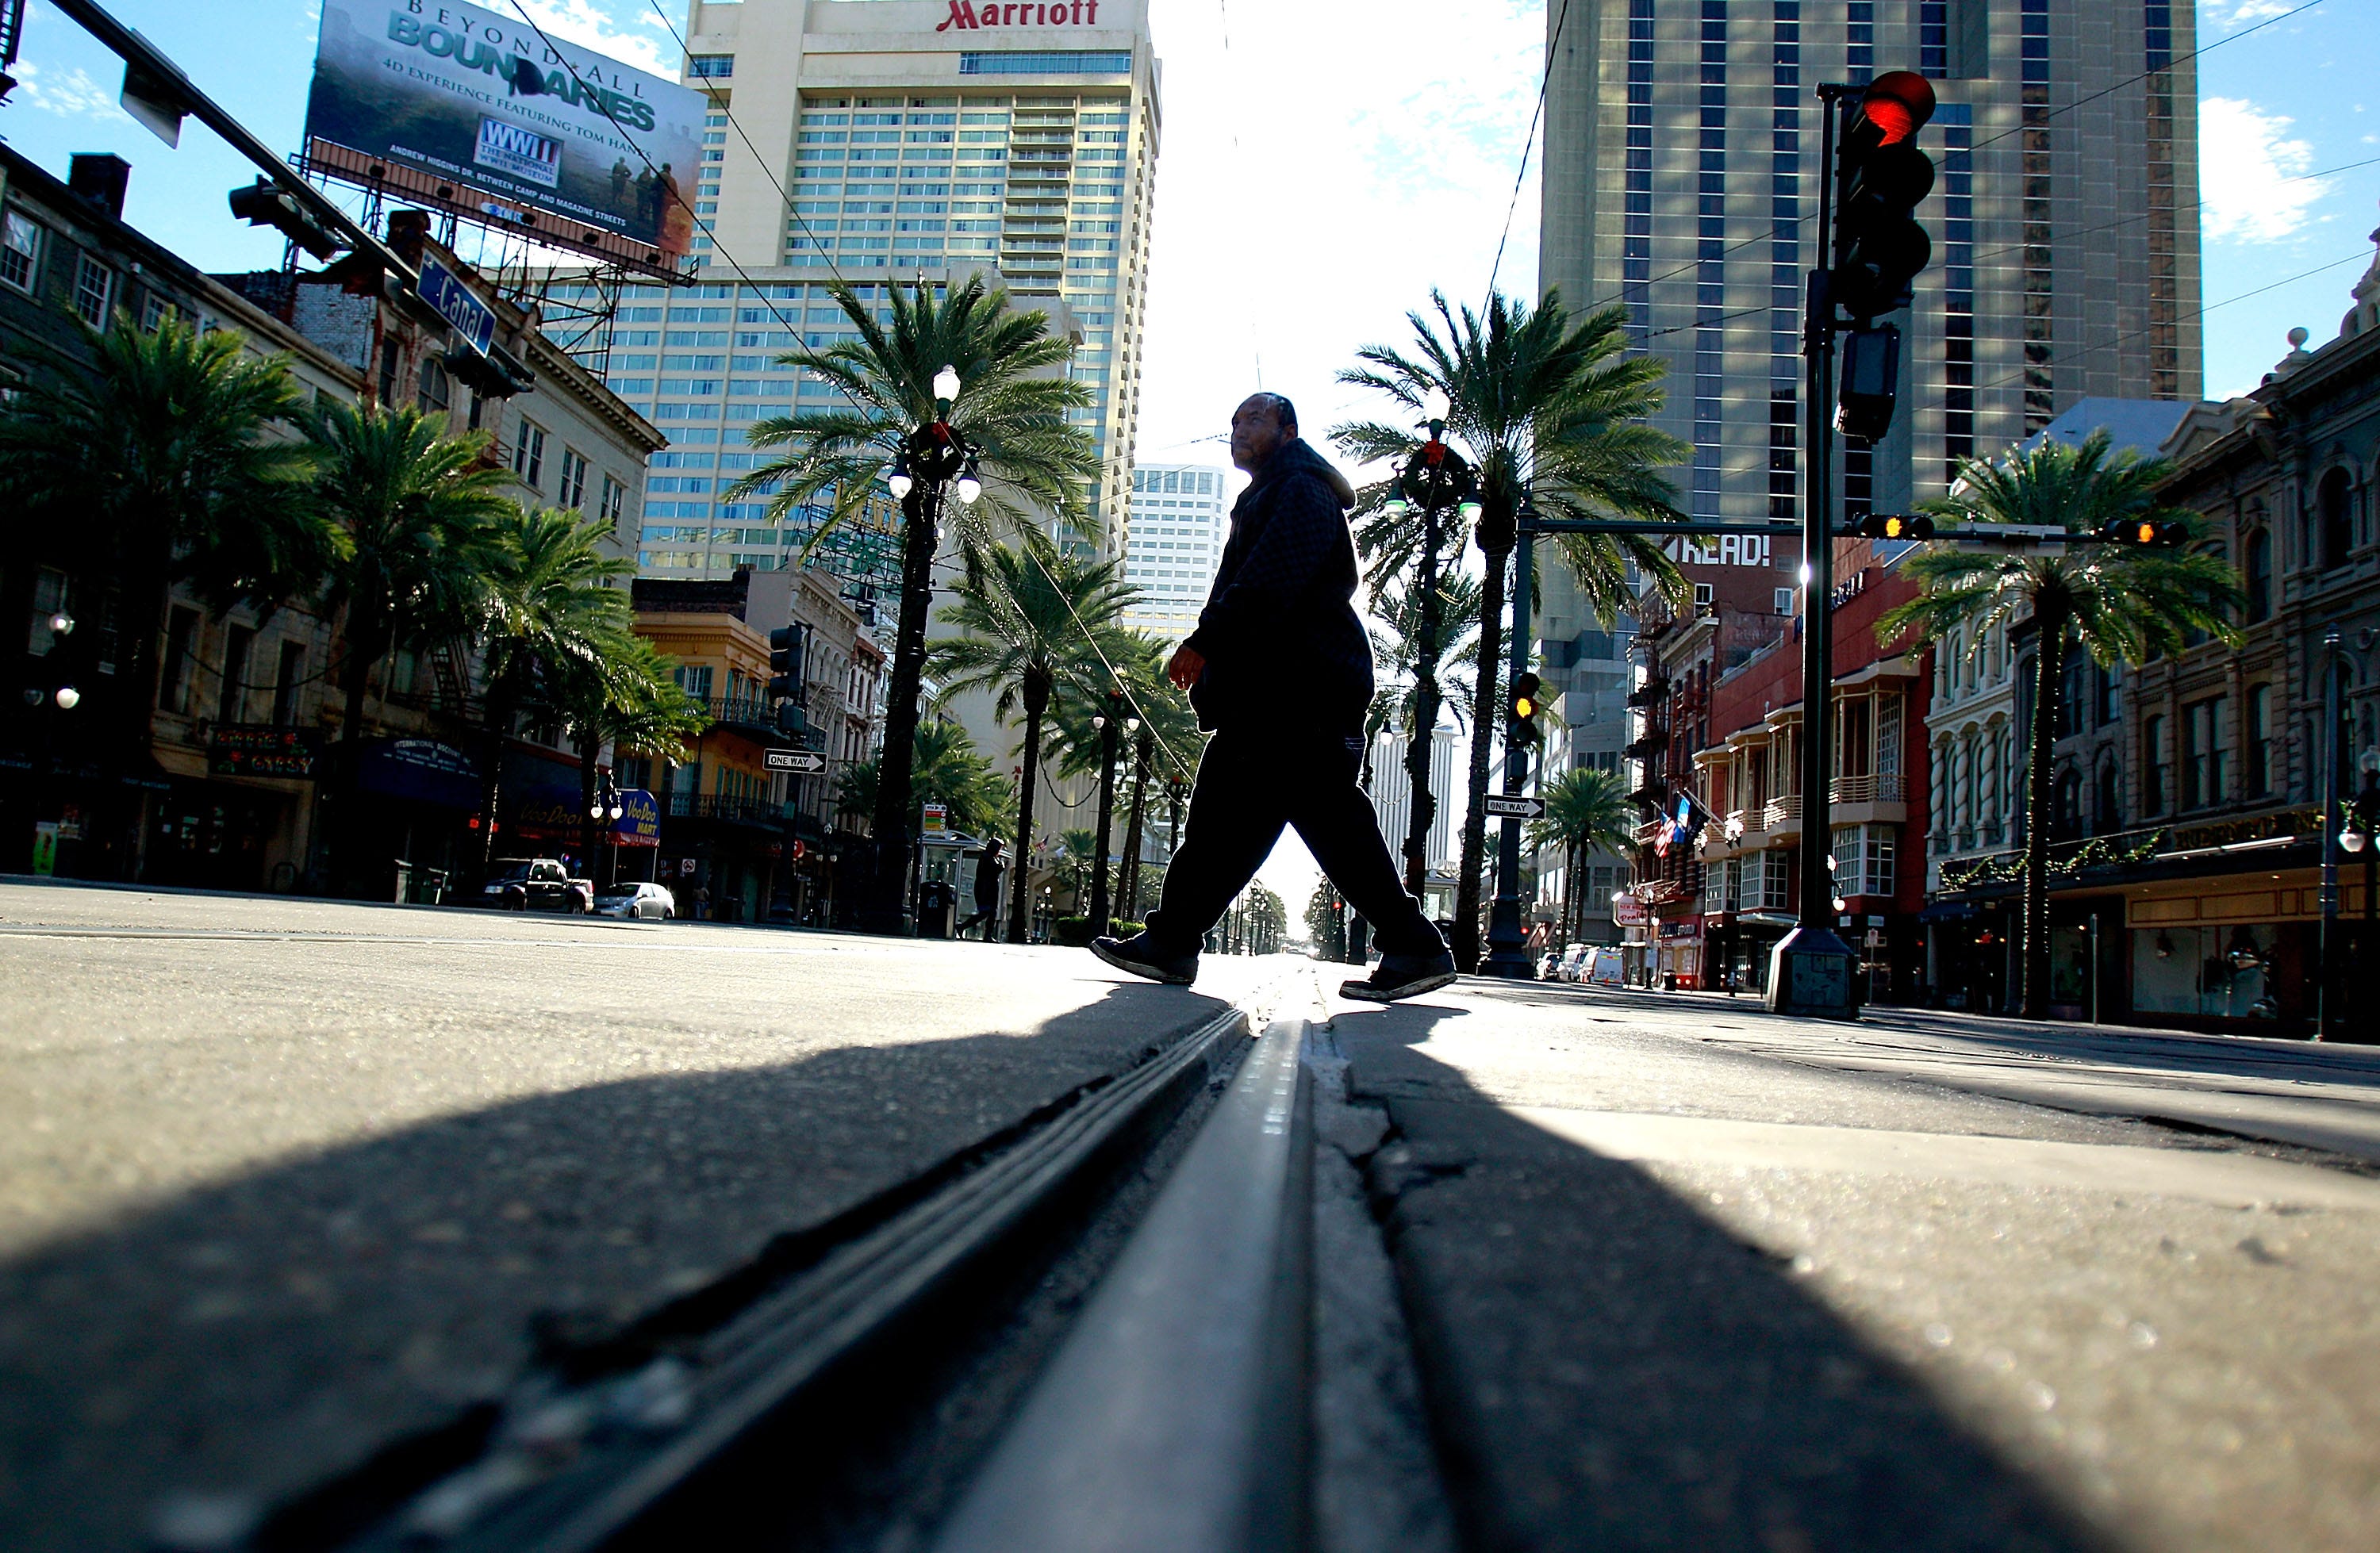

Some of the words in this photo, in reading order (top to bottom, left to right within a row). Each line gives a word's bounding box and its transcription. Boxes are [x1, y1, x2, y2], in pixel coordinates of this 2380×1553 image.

[935, 0, 1098, 32] Marriott
[408, 0, 559, 65] BEYOND
[587, 64, 644, 99] ALL
[387, 10, 655, 132] BOUNDARIES
[383, 59, 404, 73] 4D
[409, 67, 493, 105] EXPERIENCE
[497, 98, 572, 132] FEATURING
[574, 125, 604, 144] TOM
[609, 138, 651, 160] HANKS
[485, 120, 551, 163] WWII
[479, 154, 509, 168] WWII
[512, 163, 554, 183] MUSEUM
[482, 144, 501, 156] THE
[504, 151, 554, 174] NATIONAL
[390, 144, 426, 161] ANDREW
[427, 155, 461, 174] HIGGINS
[461, 167, 475, 178] DR.
[477, 172, 513, 190] BETWEEN
[515, 185, 538, 198] CAMP
[538, 193, 555, 204] AND
[556, 197, 594, 217] MAGAZINE
[595, 211, 627, 227] STREETS
[440, 275, 486, 344] Canal
[771, 756, 788, 765] ONE
[791, 757, 808, 766] WAY
[627, 798, 657, 823] VooDoo
[1490, 801, 1506, 811] ONE
[1509, 803, 1526, 812] WAY
[636, 823, 658, 836] MART
